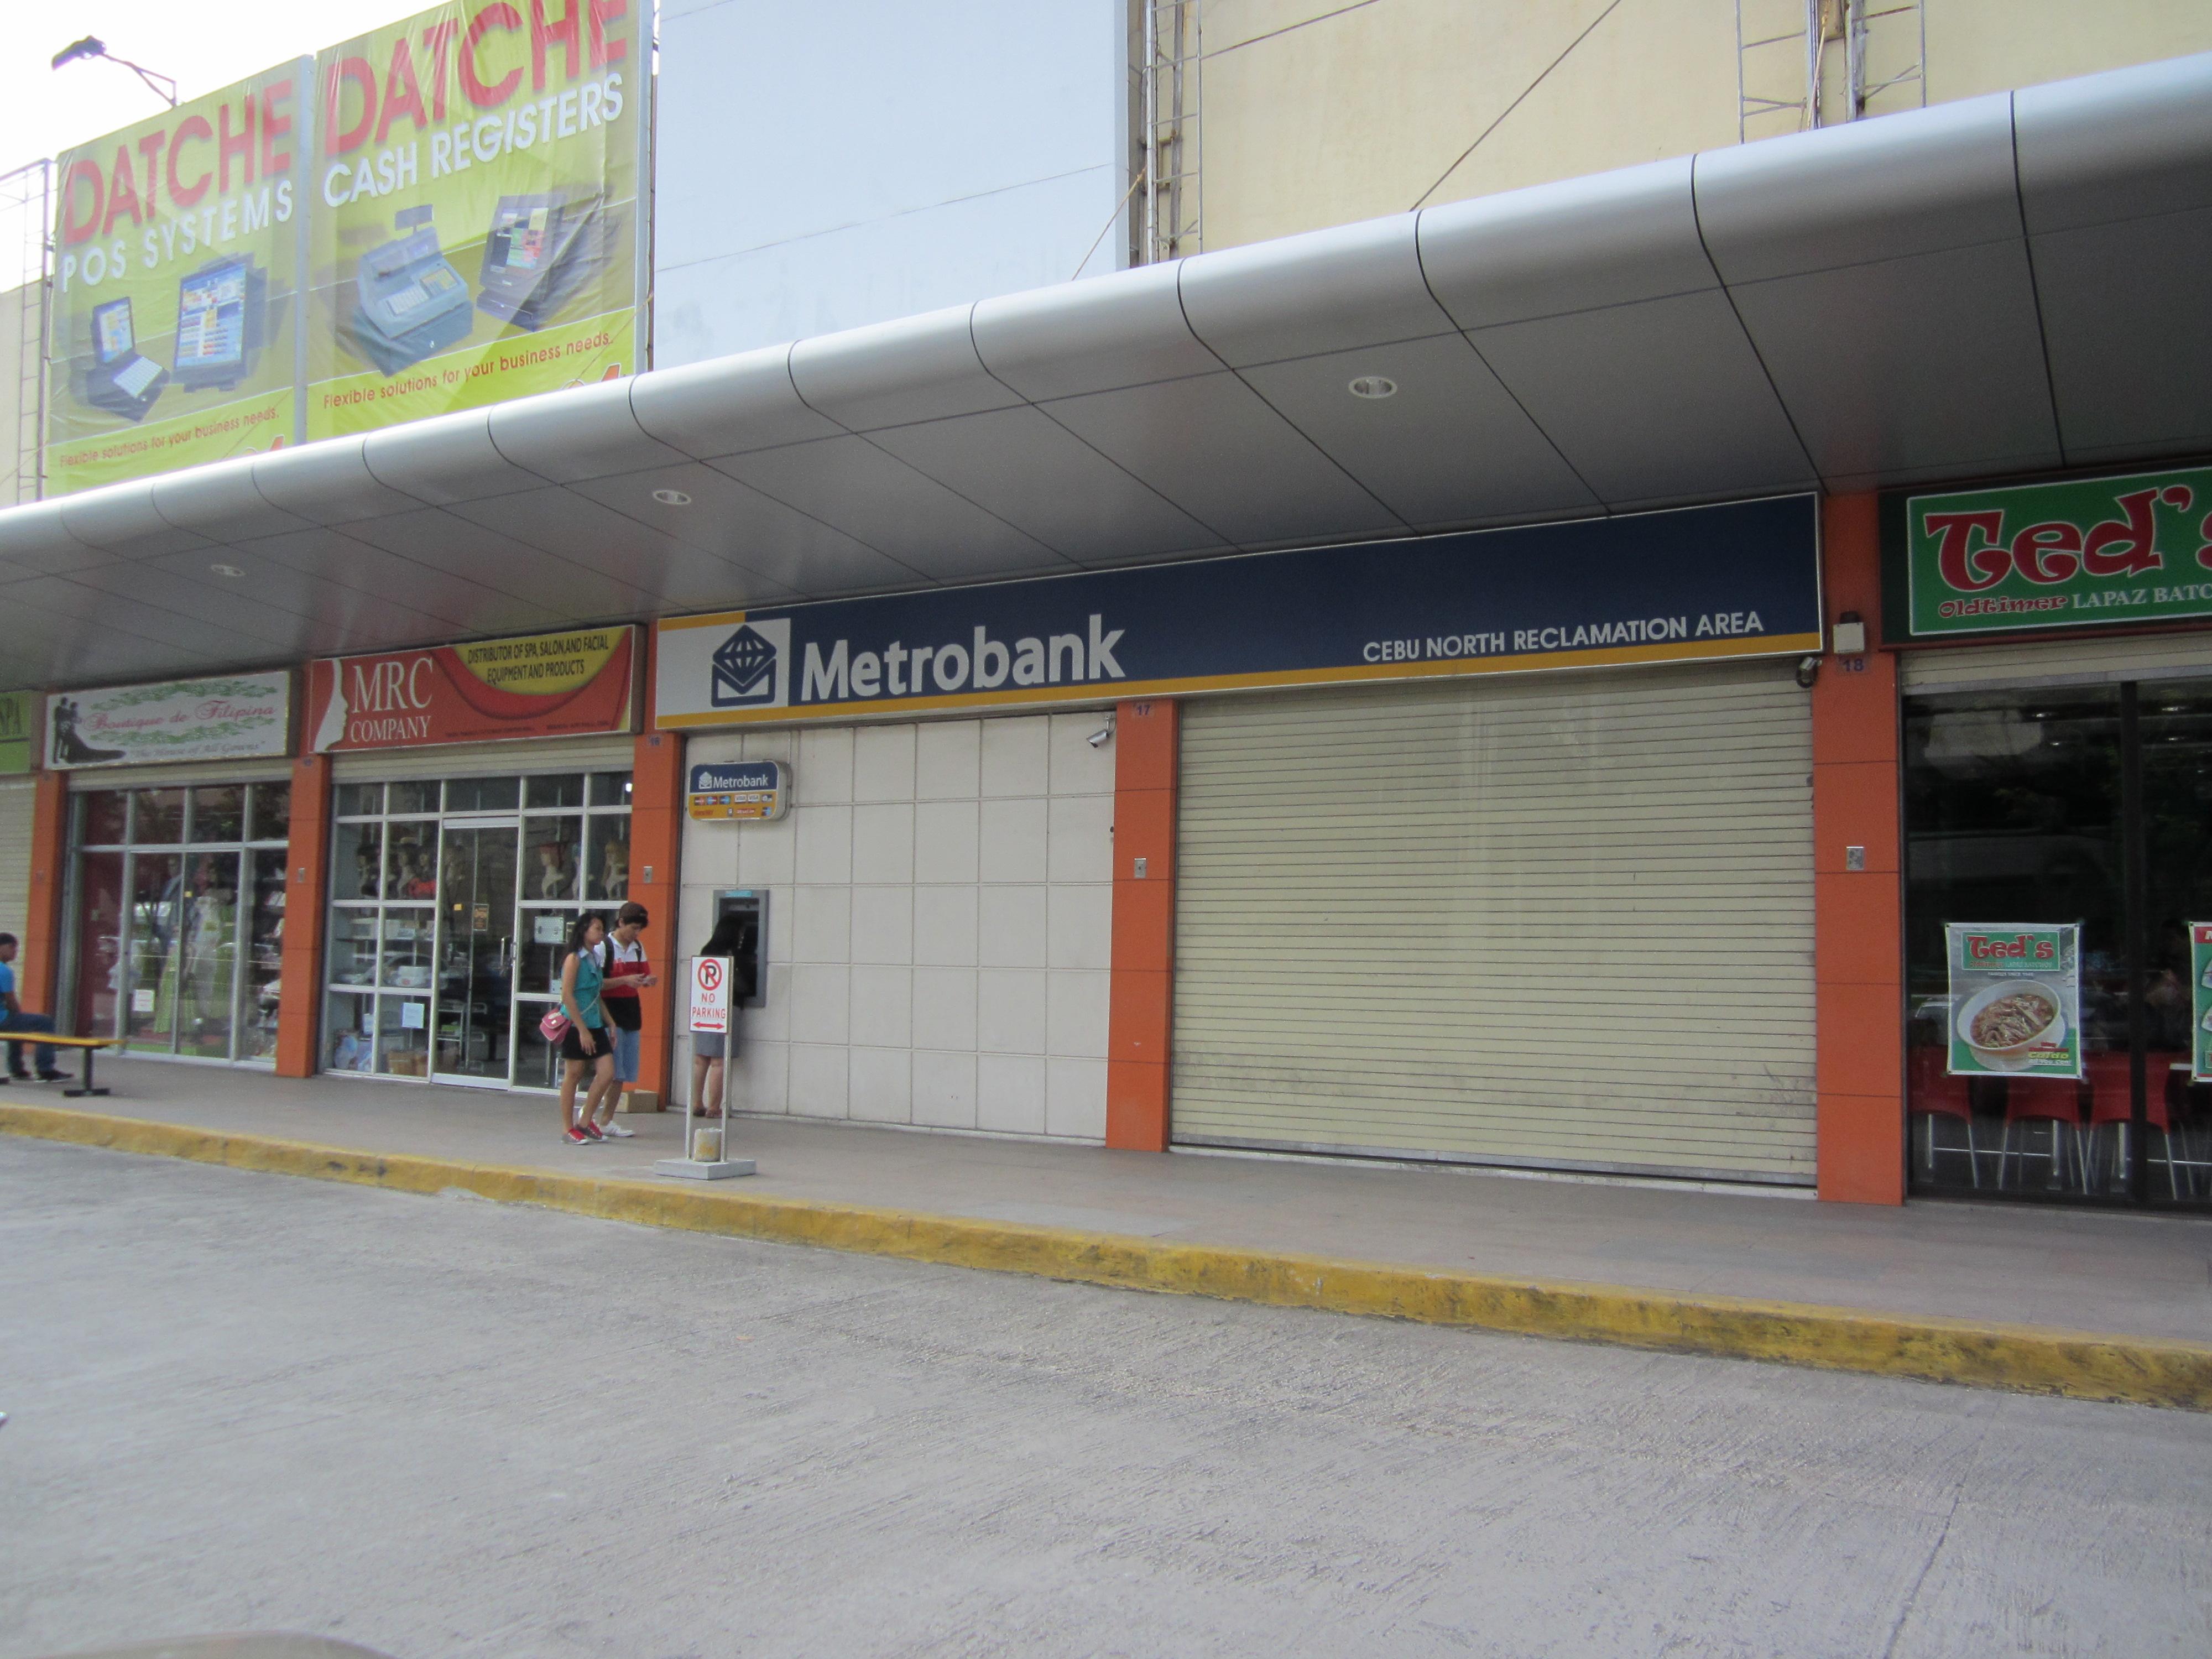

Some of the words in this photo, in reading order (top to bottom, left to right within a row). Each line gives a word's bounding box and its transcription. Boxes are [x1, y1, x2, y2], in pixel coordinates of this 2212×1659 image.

[323, 142, 418, 208] CASH
[432, 73, 623, 179] REGISTERS
[64, 79, 292, 246] DATCHE
[61, 239, 127, 293] POS
[143, 180, 293, 269] SYSTEMS
[324, 388, 375, 410] Flexible
[380, 374, 438, 398] solutions
[442, 369, 460, 384] for
[464, 359, 495, 381] your
[500, 347, 562, 372] business
[566, 330, 614, 356] needs.
[61, 447, 98, 467] Flexible
[102, 440, 148, 460] solutions
[151, 435, 166, 449] for
[168, 429, 192, 446] your
[195, 418, 240, 439] business
[243, 405, 280, 429] needs.
[1923, 484, 2212, 592] Ted'
[1938, 596, 2068, 618] Oldtimer
[2072, 588, 2148, 609] LAPAZ
[468, 645, 512, 664] DISTRIBUTOR
[513, 644, 524, 659] OF
[525, 643, 539, 658] SPA,
[583, 635, 608, 651] FACIAL
[1363, 639, 1420, 662] CEBU
[1426, 632, 1505, 658] NORTH
[1514, 616, 1687, 650] RECLAMATION
[1695, 611, 1764, 637] AREA
[487, 665, 528, 685] EQUIPMENT
[528, 664, 543, 679] AND
[545, 659, 585, 677] PRODUCTS
[801, 613, 1126, 702] Metrobank
[1844, 658, 1864, 672] 18
[352, 658, 433, 713] MRC
[1136, 705, 1150, 716] 17
[350, 716, 431, 743] COMPANY
[713, 774, 769, 789] Metrobank
[1966, 933, 2054, 959] Ted's
[692, 1006, 726, 1019] PARKING
[701, 993, 715, 1003] NO
